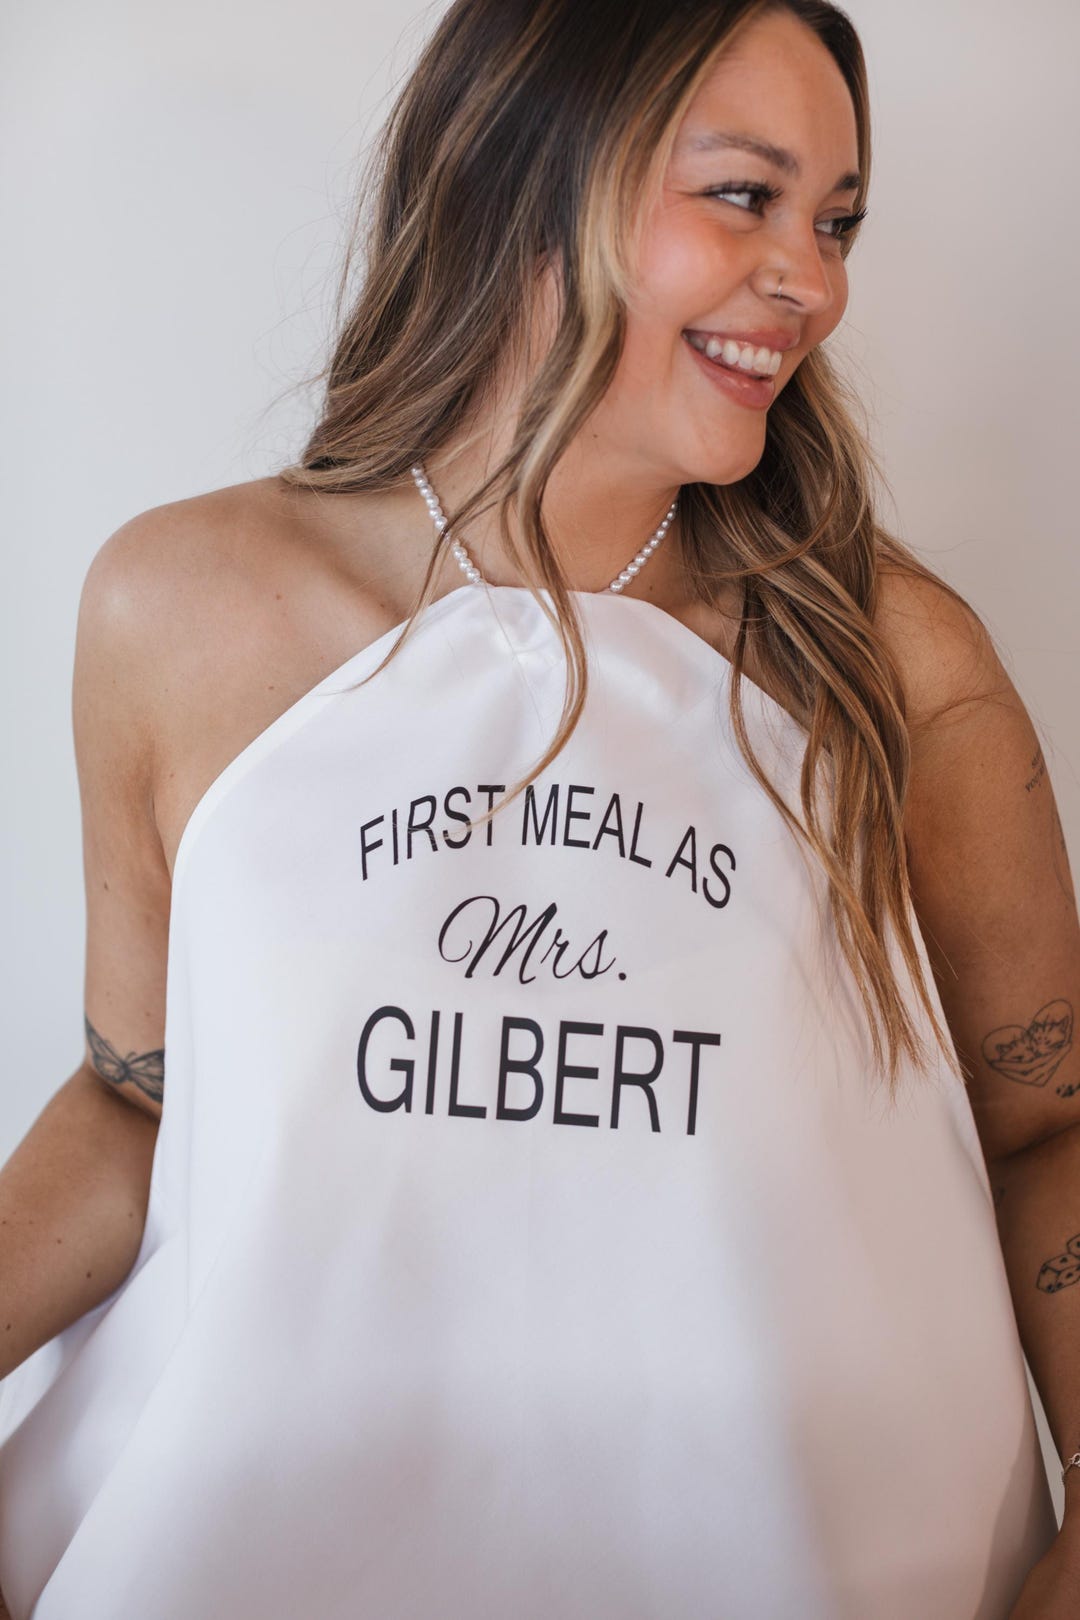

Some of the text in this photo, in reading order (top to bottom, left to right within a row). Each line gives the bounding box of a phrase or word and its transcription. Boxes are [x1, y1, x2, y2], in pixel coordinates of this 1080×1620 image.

[359, 783, 737, 909] FIRST MEAL AS
[437, 895, 628, 985] Mrs.
[356, 1005, 722, 1136] GILBERT
